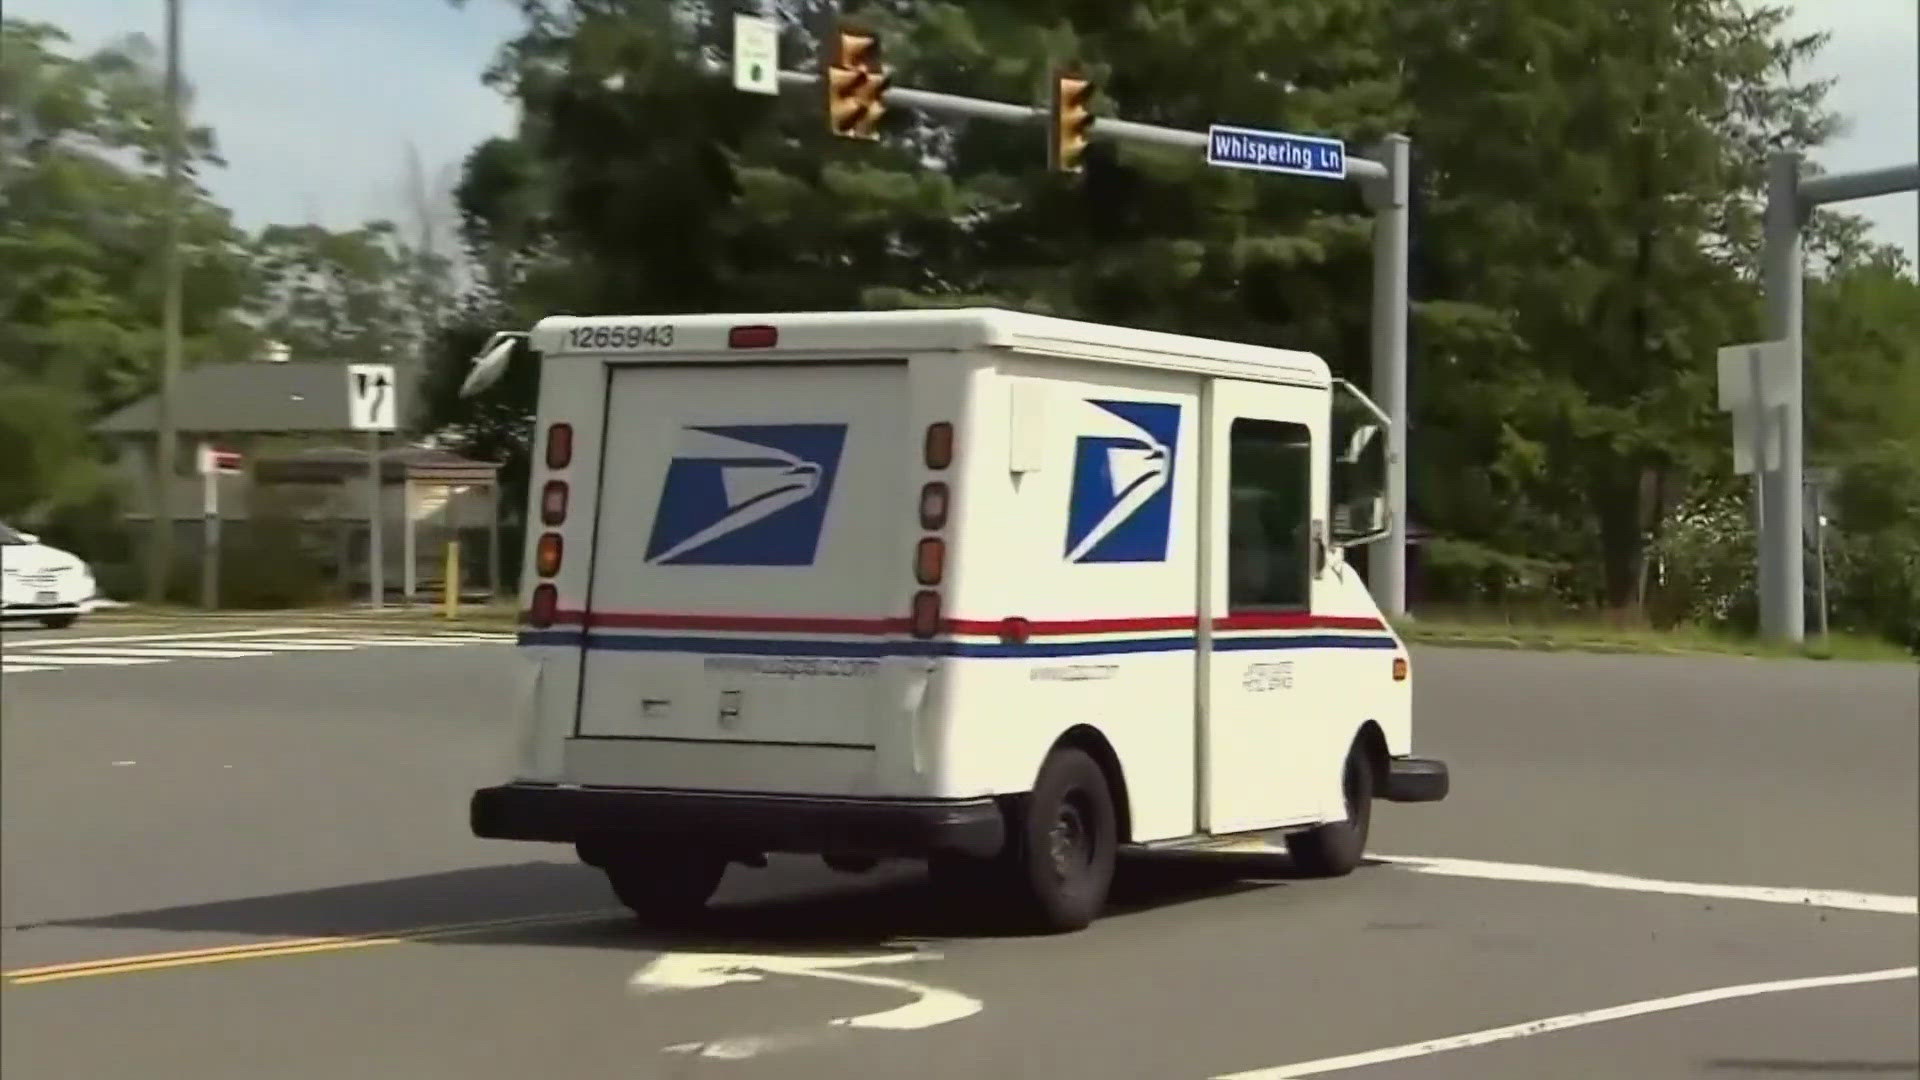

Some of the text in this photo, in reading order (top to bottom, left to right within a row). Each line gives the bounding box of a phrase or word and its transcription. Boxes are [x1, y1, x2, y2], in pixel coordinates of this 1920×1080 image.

[1215, 134, 1340, 170] Whispering Ln
[569, 325, 674, 348] 1265943
